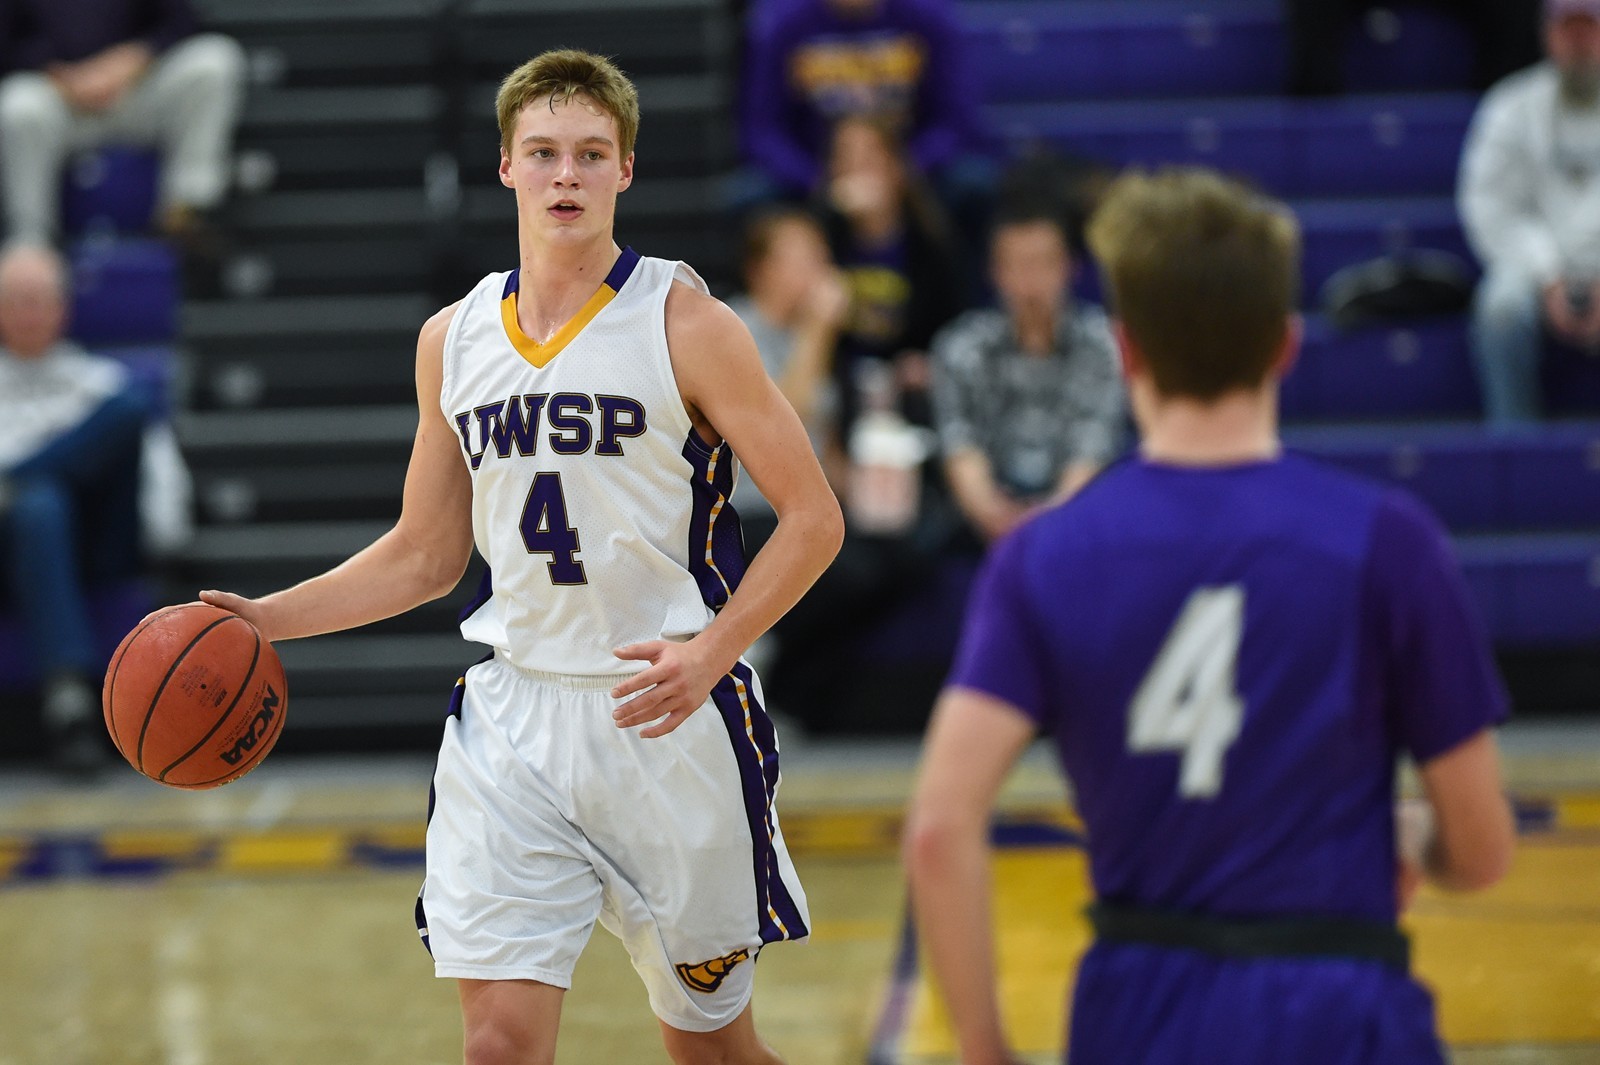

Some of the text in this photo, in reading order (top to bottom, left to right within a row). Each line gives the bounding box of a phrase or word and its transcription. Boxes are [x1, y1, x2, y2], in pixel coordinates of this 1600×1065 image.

[455, 392, 647, 470] UWSP
[519, 471, 588, 585] 4
[219, 683, 279, 766] NCAA
[1126, 583, 1244, 798] 4
